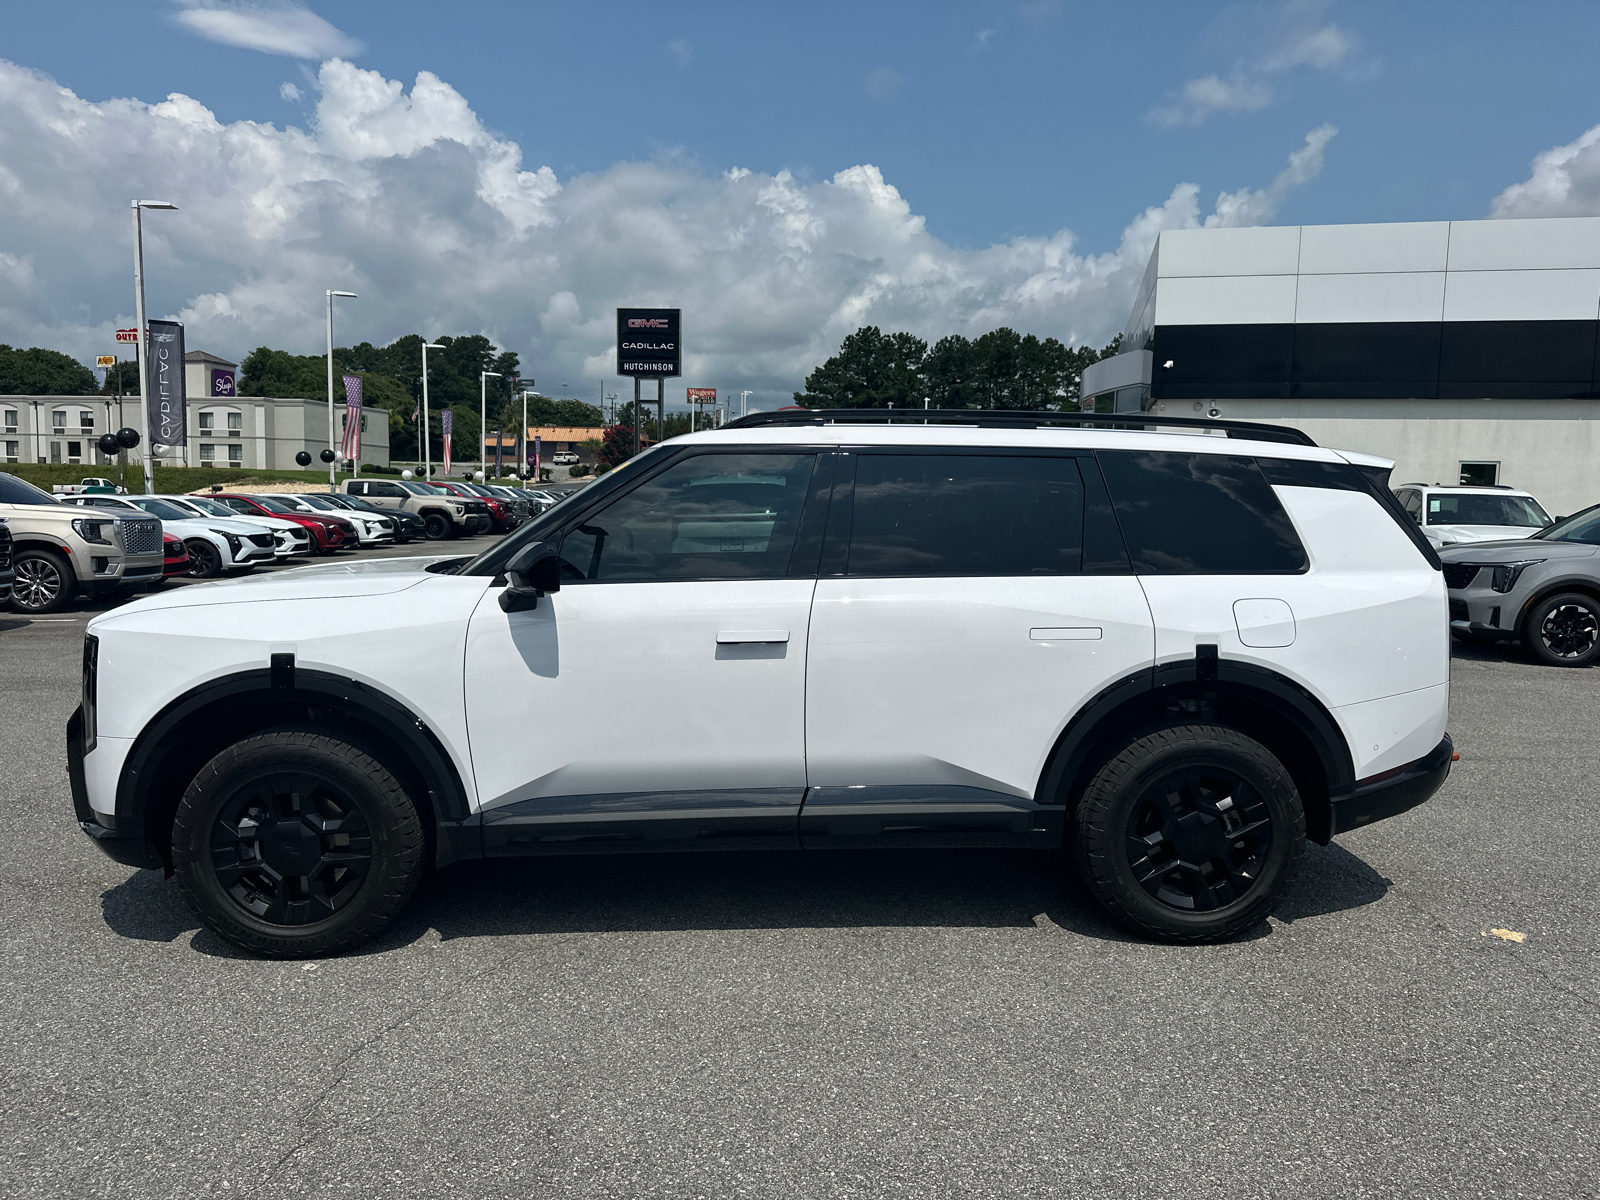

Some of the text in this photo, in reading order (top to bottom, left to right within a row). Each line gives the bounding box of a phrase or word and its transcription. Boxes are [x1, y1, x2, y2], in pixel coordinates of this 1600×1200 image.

[628, 319, 669, 328] GMC
[116, 333, 149, 341] OUTB
[624, 363, 673, 371] HUTCHINSON
[216, 379, 232, 392] Sleep
